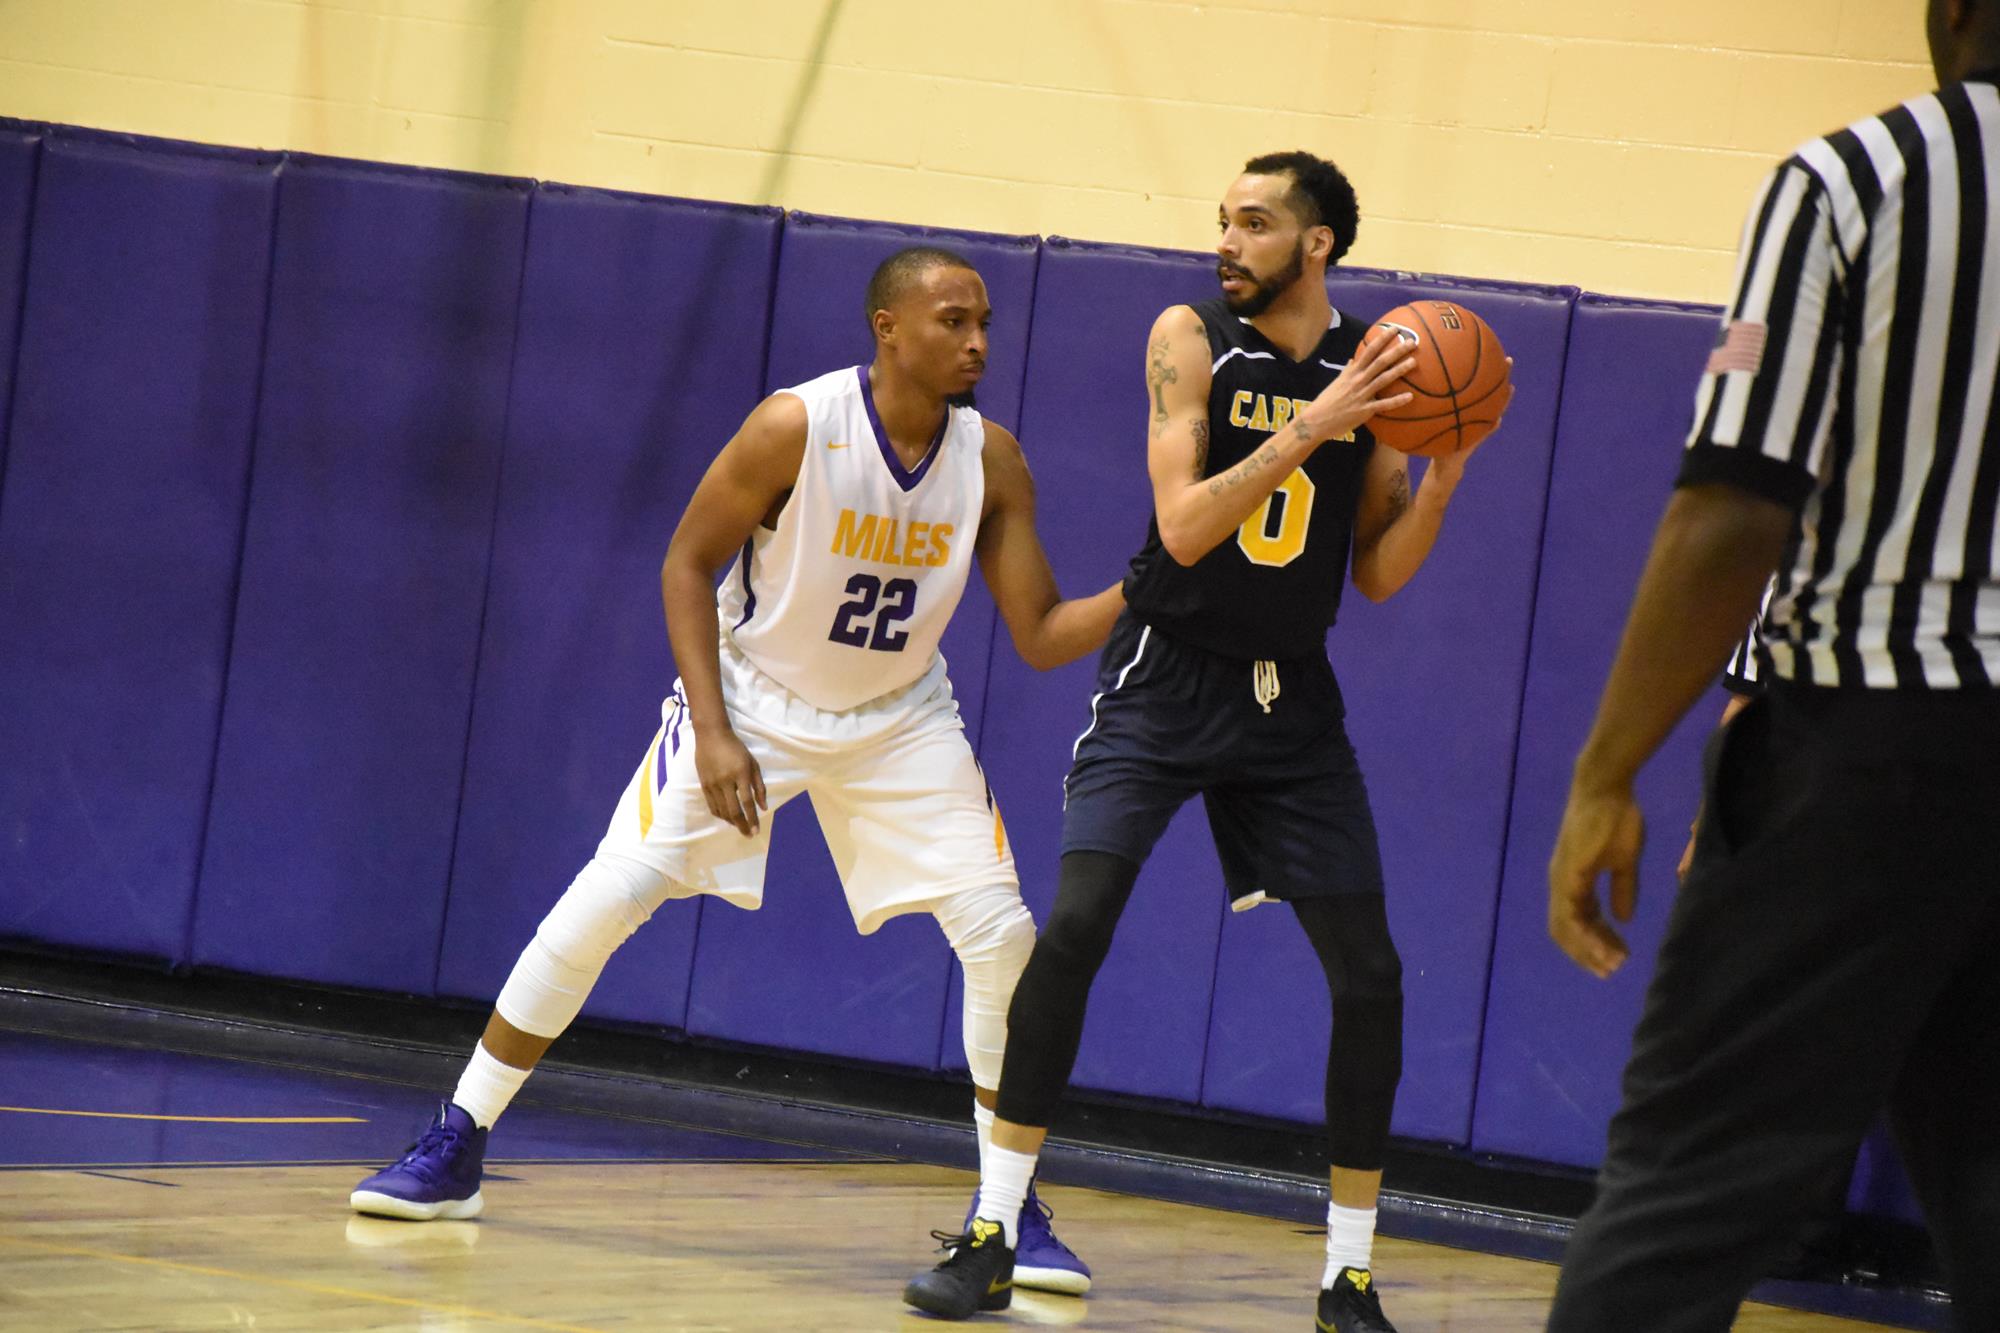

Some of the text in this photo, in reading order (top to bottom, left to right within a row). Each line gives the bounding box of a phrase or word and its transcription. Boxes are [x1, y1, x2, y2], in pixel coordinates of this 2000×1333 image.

[1230, 390, 1356, 443] CAR
[831, 508, 954, 567] MILES
[1237, 466, 1315, 568] 0
[828, 573, 918, 652] 22
